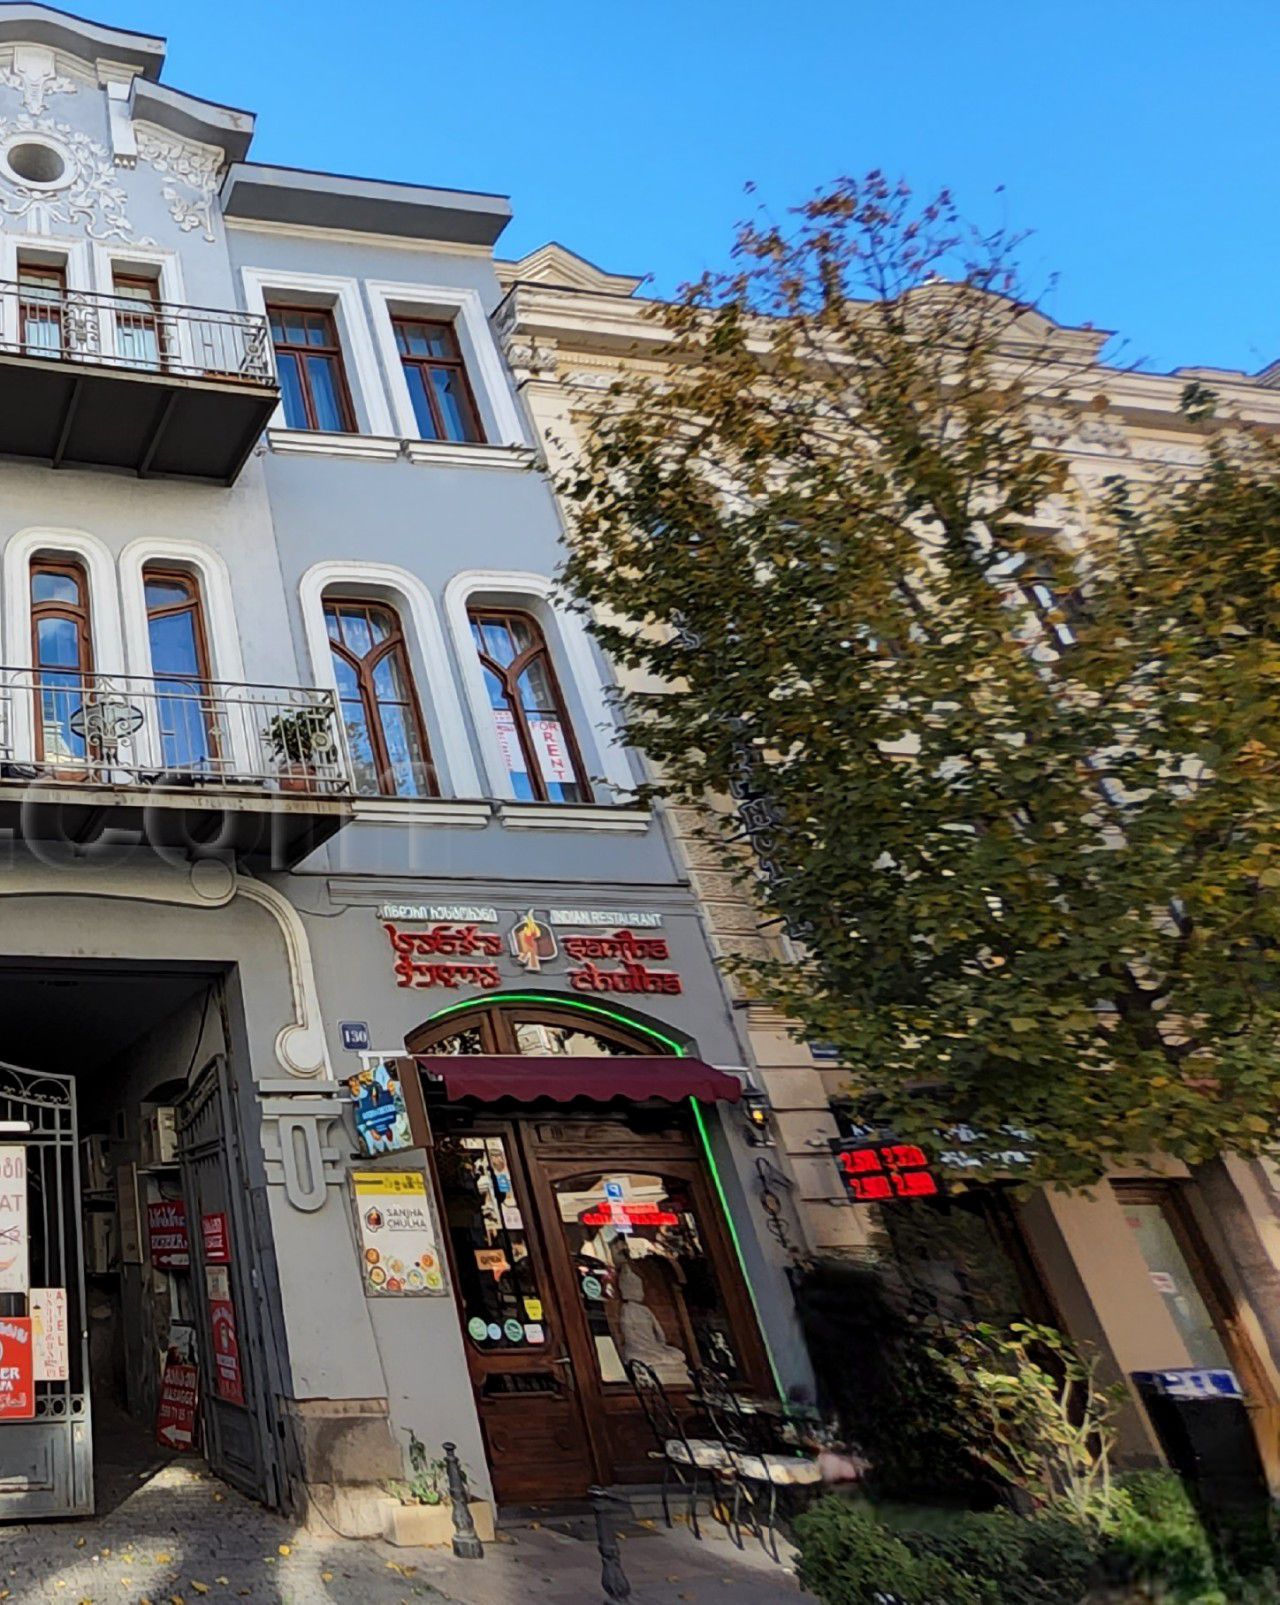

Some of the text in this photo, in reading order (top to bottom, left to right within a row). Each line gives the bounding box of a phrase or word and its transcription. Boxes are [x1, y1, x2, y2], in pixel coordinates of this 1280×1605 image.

[543, 732, 566, 780] RENT
[550, 909, 663, 927] INDIAN RESTAURANT
[344, 1029, 368, 1044] 130
